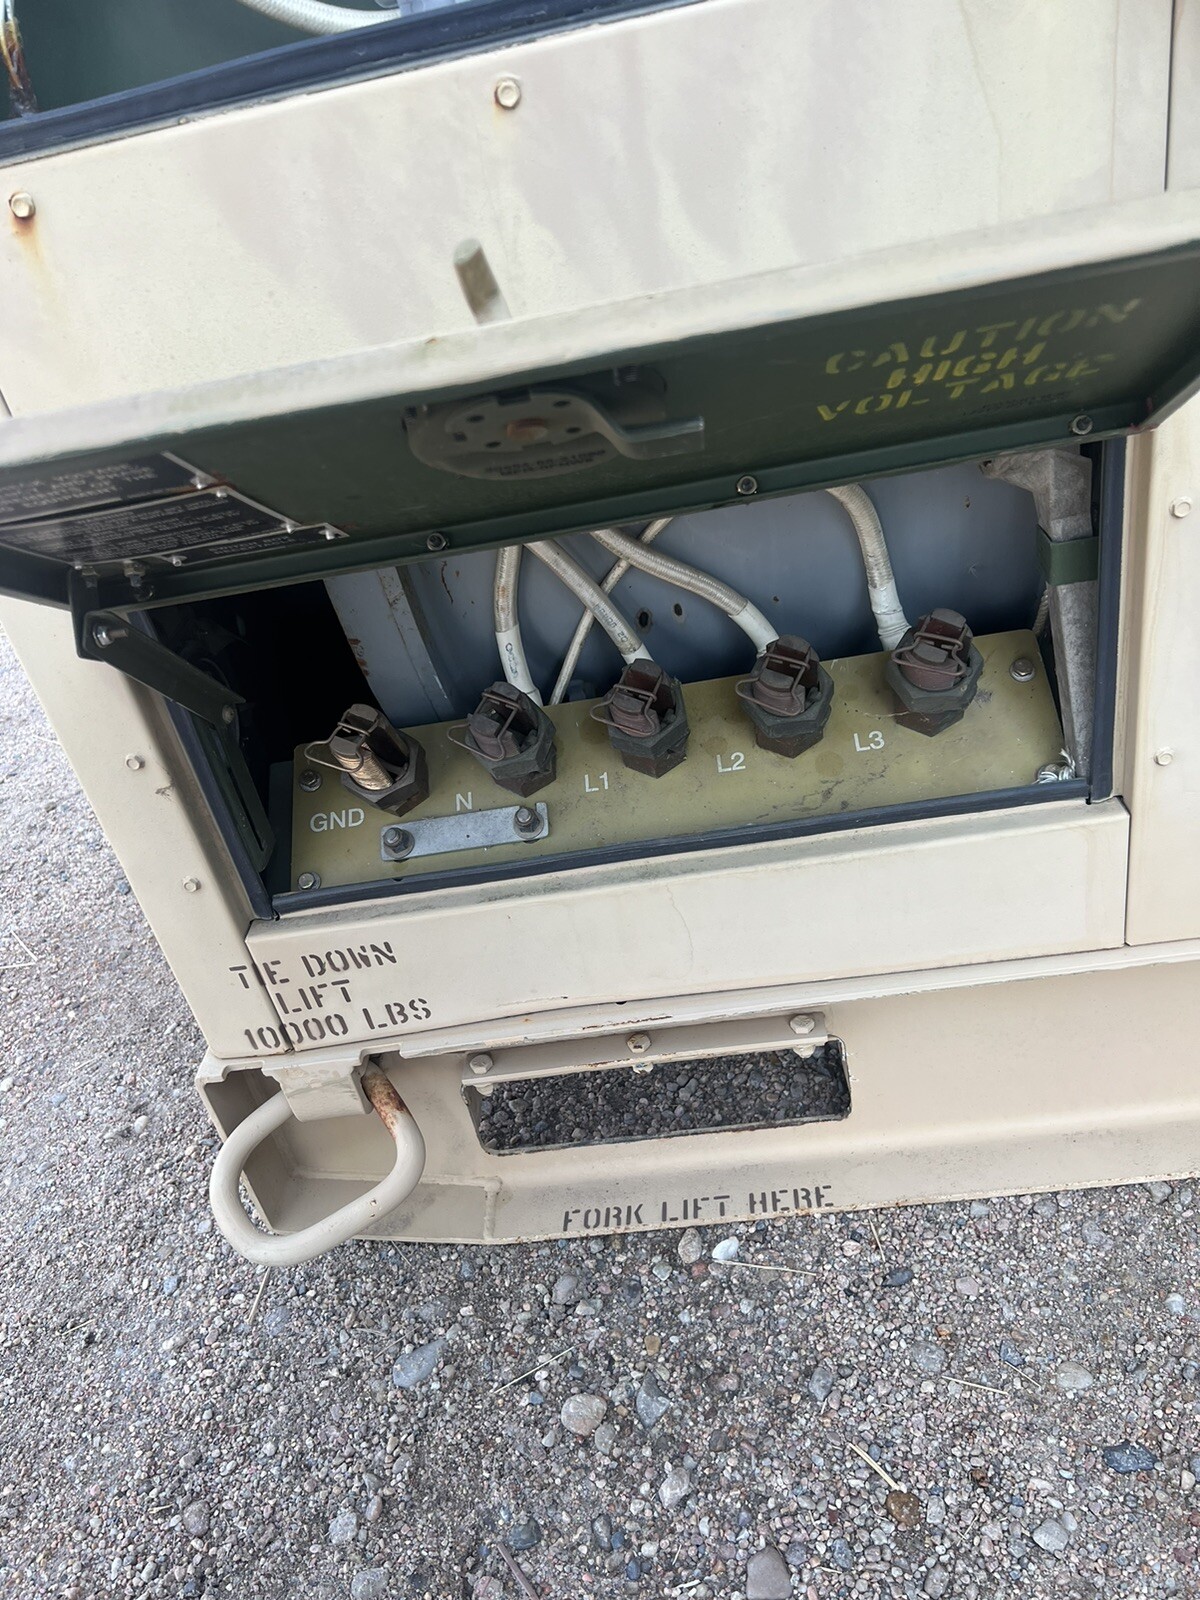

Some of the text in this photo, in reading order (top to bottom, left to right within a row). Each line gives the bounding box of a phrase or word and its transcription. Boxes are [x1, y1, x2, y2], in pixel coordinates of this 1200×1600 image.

[825, 298, 1141, 374] CAUTION
[886, 341, 1047, 389] HIGH
[853, 730, 885, 752] L3
[716, 751, 746, 773] L2
[584, 772, 609, 793] L1
[455, 791, 473, 812] N
[309, 807, 365, 833] GND
[301, 941, 397, 978] DOWN
[275, 979, 352, 1015] LIFT
[244, 998, 432, 1050] 10000 LBS
[562, 1184, 834, 1232] FORK LIFT HERE
